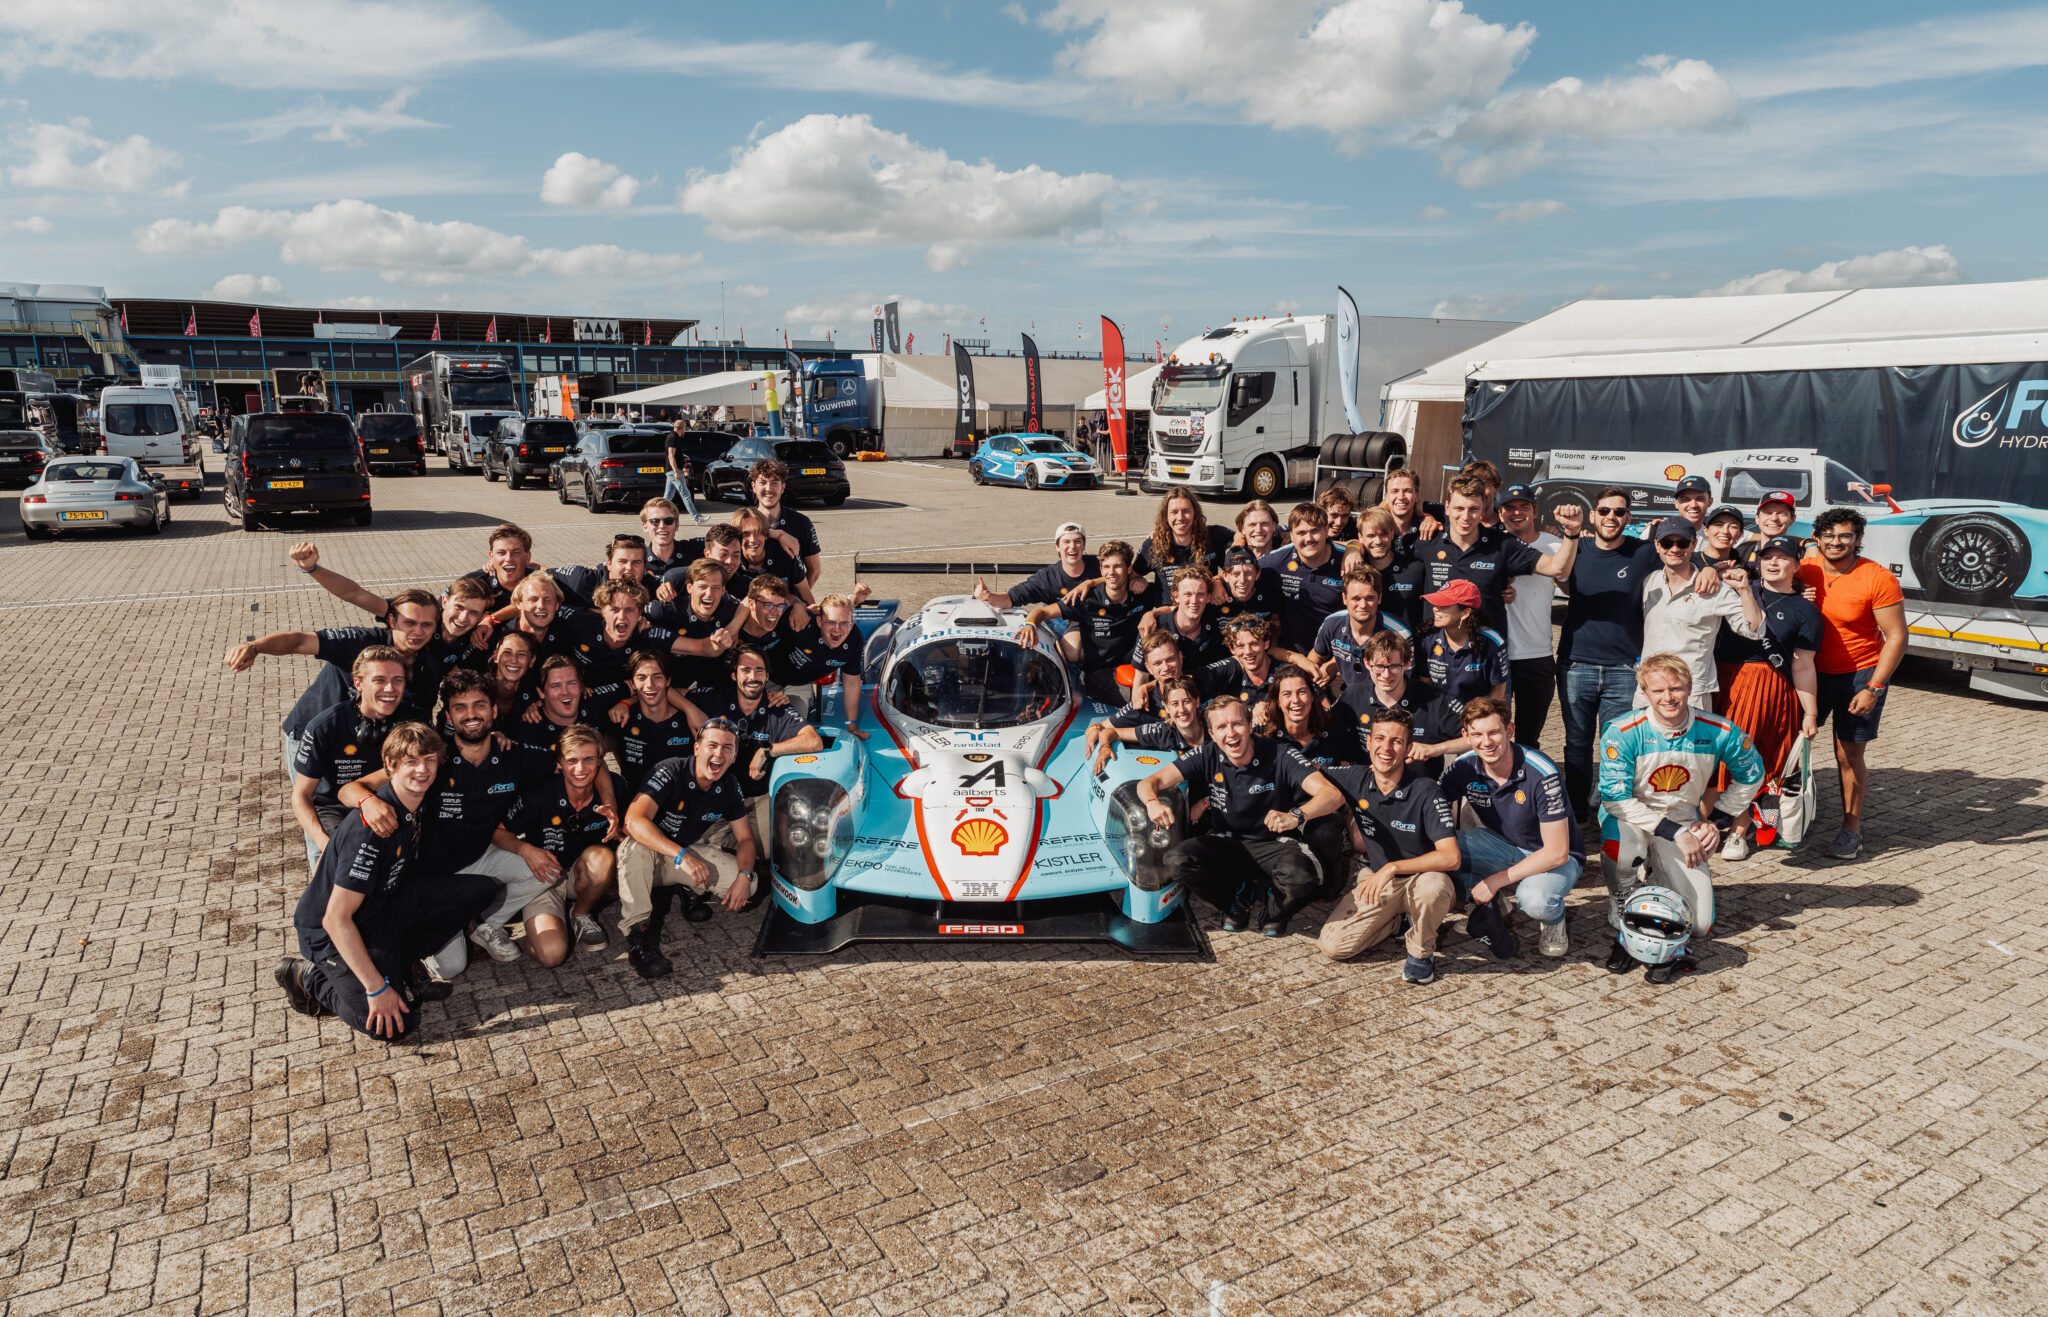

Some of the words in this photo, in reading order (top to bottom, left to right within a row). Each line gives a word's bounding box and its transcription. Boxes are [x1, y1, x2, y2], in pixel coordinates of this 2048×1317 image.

[814, 398, 857, 413] Louwman
[2005, 379, 2048, 429] F
[1555, 452, 1586, 460] Airborne
[917, 724, 952, 748] KISTLER
[1013, 735, 1031, 750] EKPO
[494, 782, 515, 791] Forze
[953, 788, 1007, 796] aalberts
[1395, 820, 1416, 830] Forze
[854, 836, 920, 850] REFIRE
[1038, 832, 1103, 846] REFIRE
[844, 859, 883, 870] EKPO
[1033, 852, 1104, 869] KISTLER
[961, 882, 999, 897] IBM
